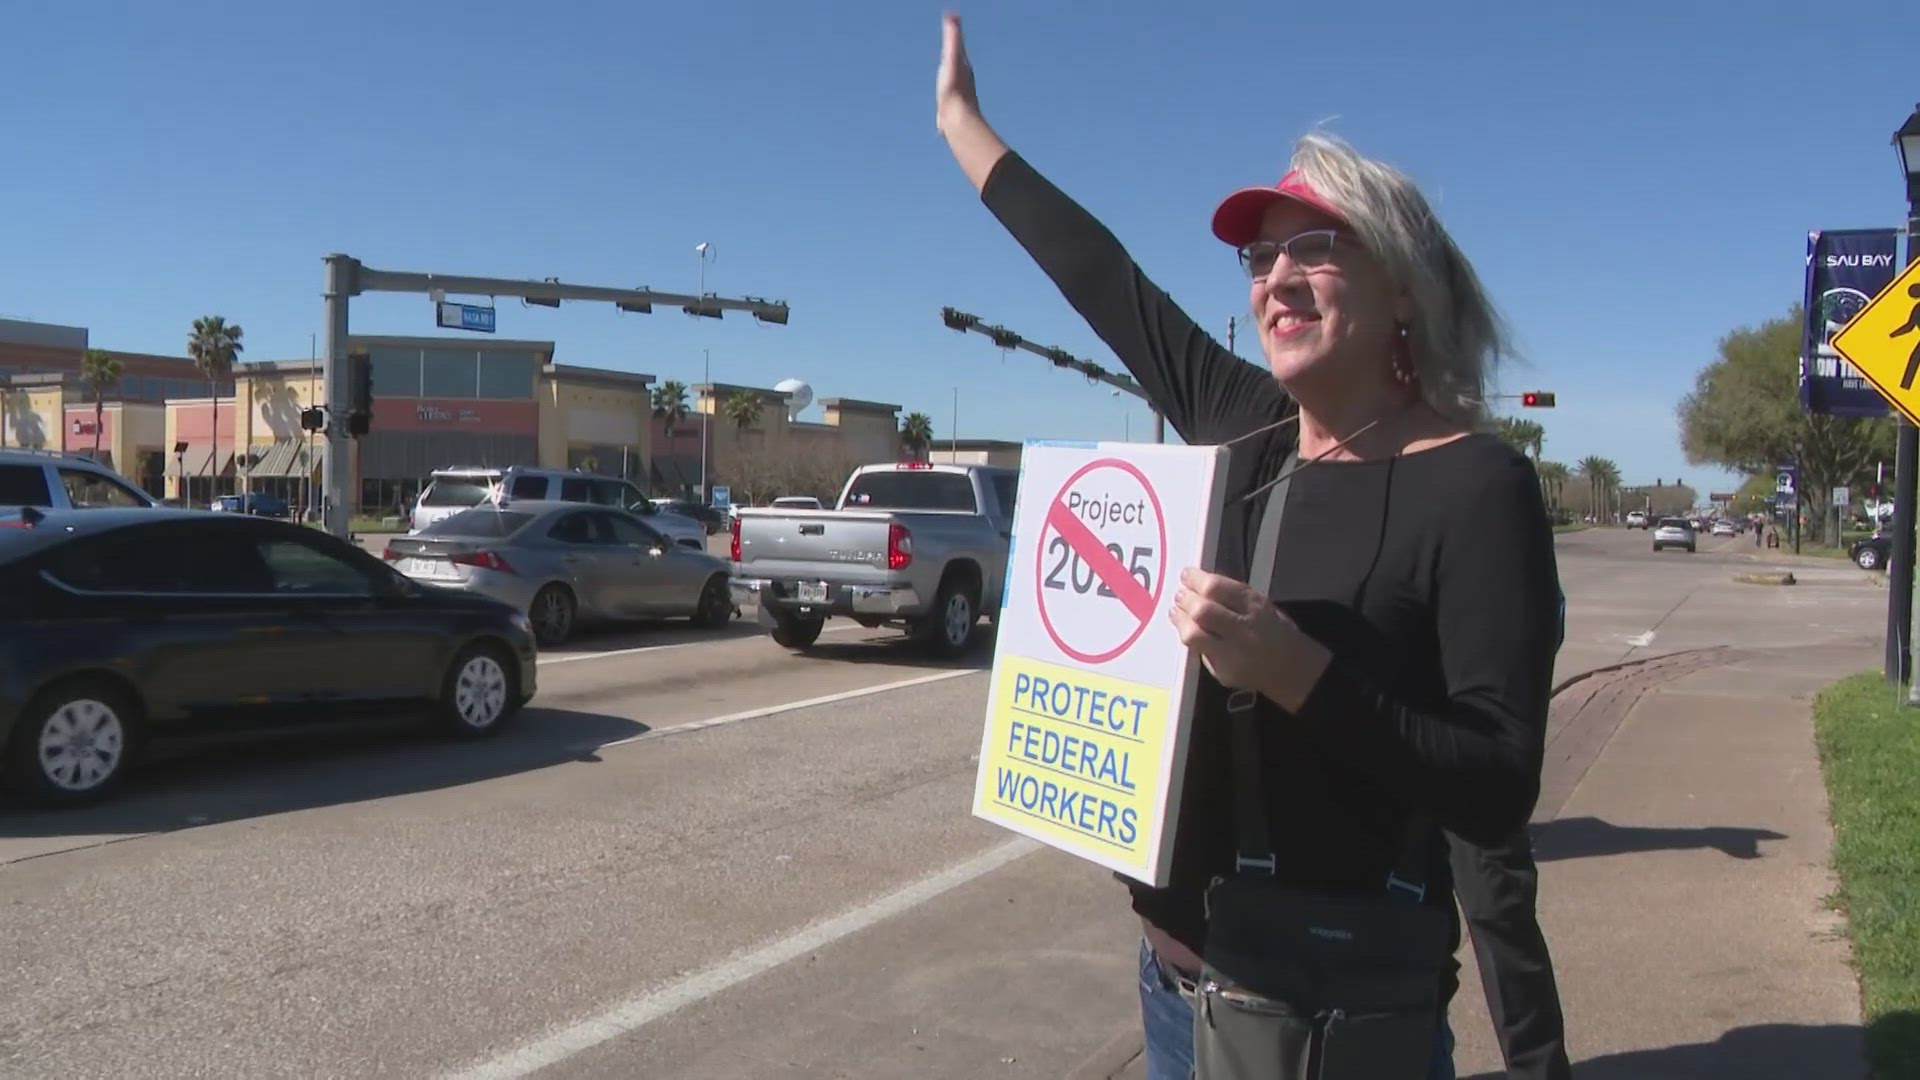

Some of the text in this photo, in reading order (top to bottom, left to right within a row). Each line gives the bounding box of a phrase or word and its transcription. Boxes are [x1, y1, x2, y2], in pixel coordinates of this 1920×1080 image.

[1862, 253, 1893, 266] BAY
[1069, 492, 1145, 532] Project
[1014, 672, 1149, 736] PROTECT
[1009, 721, 1136, 790] FEDERAL
[998, 767, 1138, 844] WORKERS
